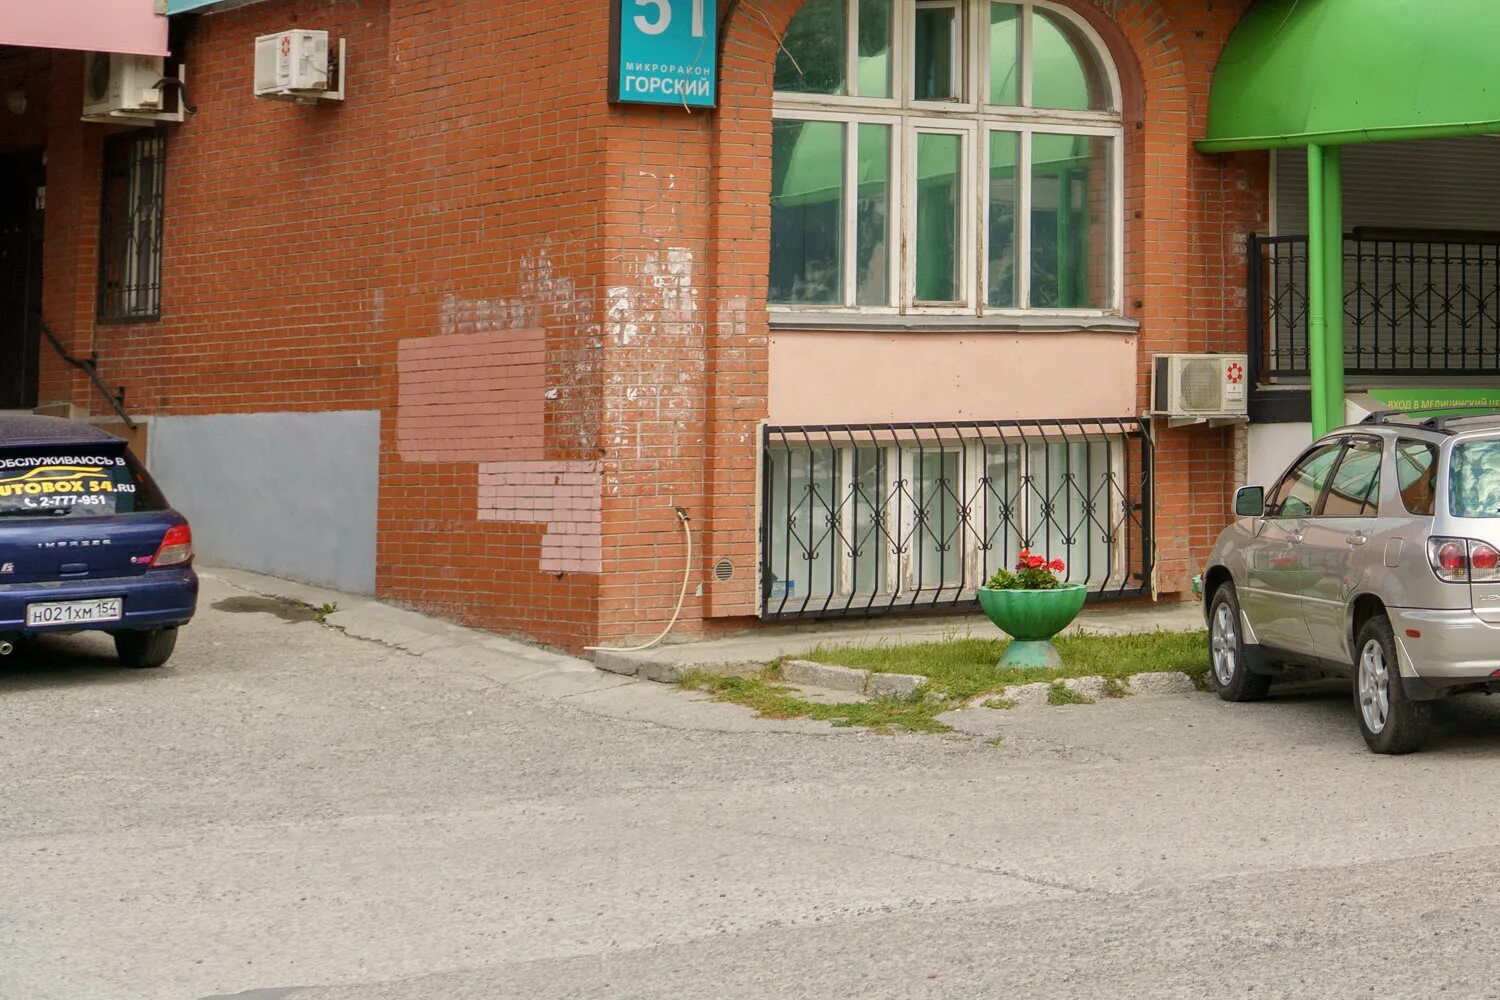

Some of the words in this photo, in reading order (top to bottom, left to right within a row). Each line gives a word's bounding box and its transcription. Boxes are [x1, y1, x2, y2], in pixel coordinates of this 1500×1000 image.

[625, 75, 710, 96] ГОРСКИЙ
[1389, 400, 1411, 409] ВХОД
[1414, 400, 1419, 409] В
[116, 457, 126, 466] В
[0, 481, 84, 496] UTOBOX
[40, 495, 105, 507] 2-777-951
[95, 602, 116, 614] 154
